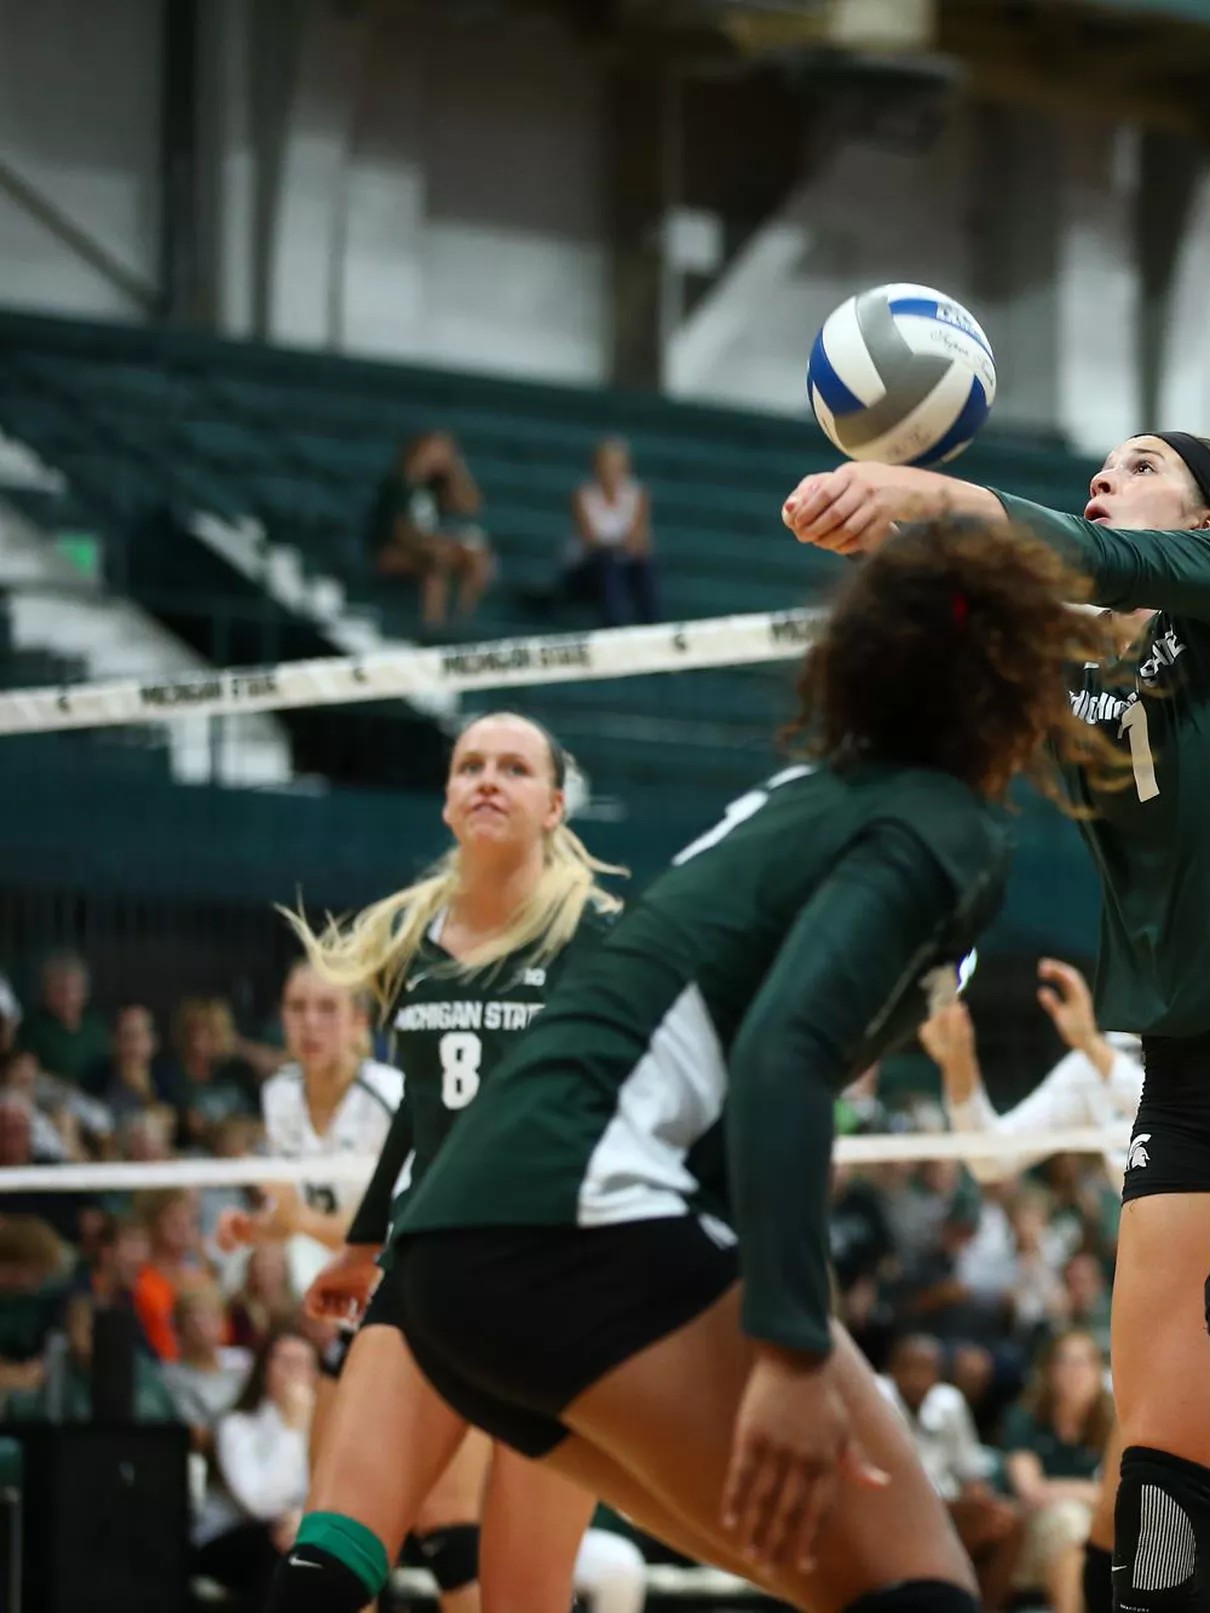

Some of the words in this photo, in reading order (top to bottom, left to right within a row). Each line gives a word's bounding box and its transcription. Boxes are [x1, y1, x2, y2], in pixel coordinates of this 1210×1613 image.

[1117, 700, 1161, 803] 1
[483, 1001, 547, 1031] STAT
[439, 1031, 482, 1110] 8
